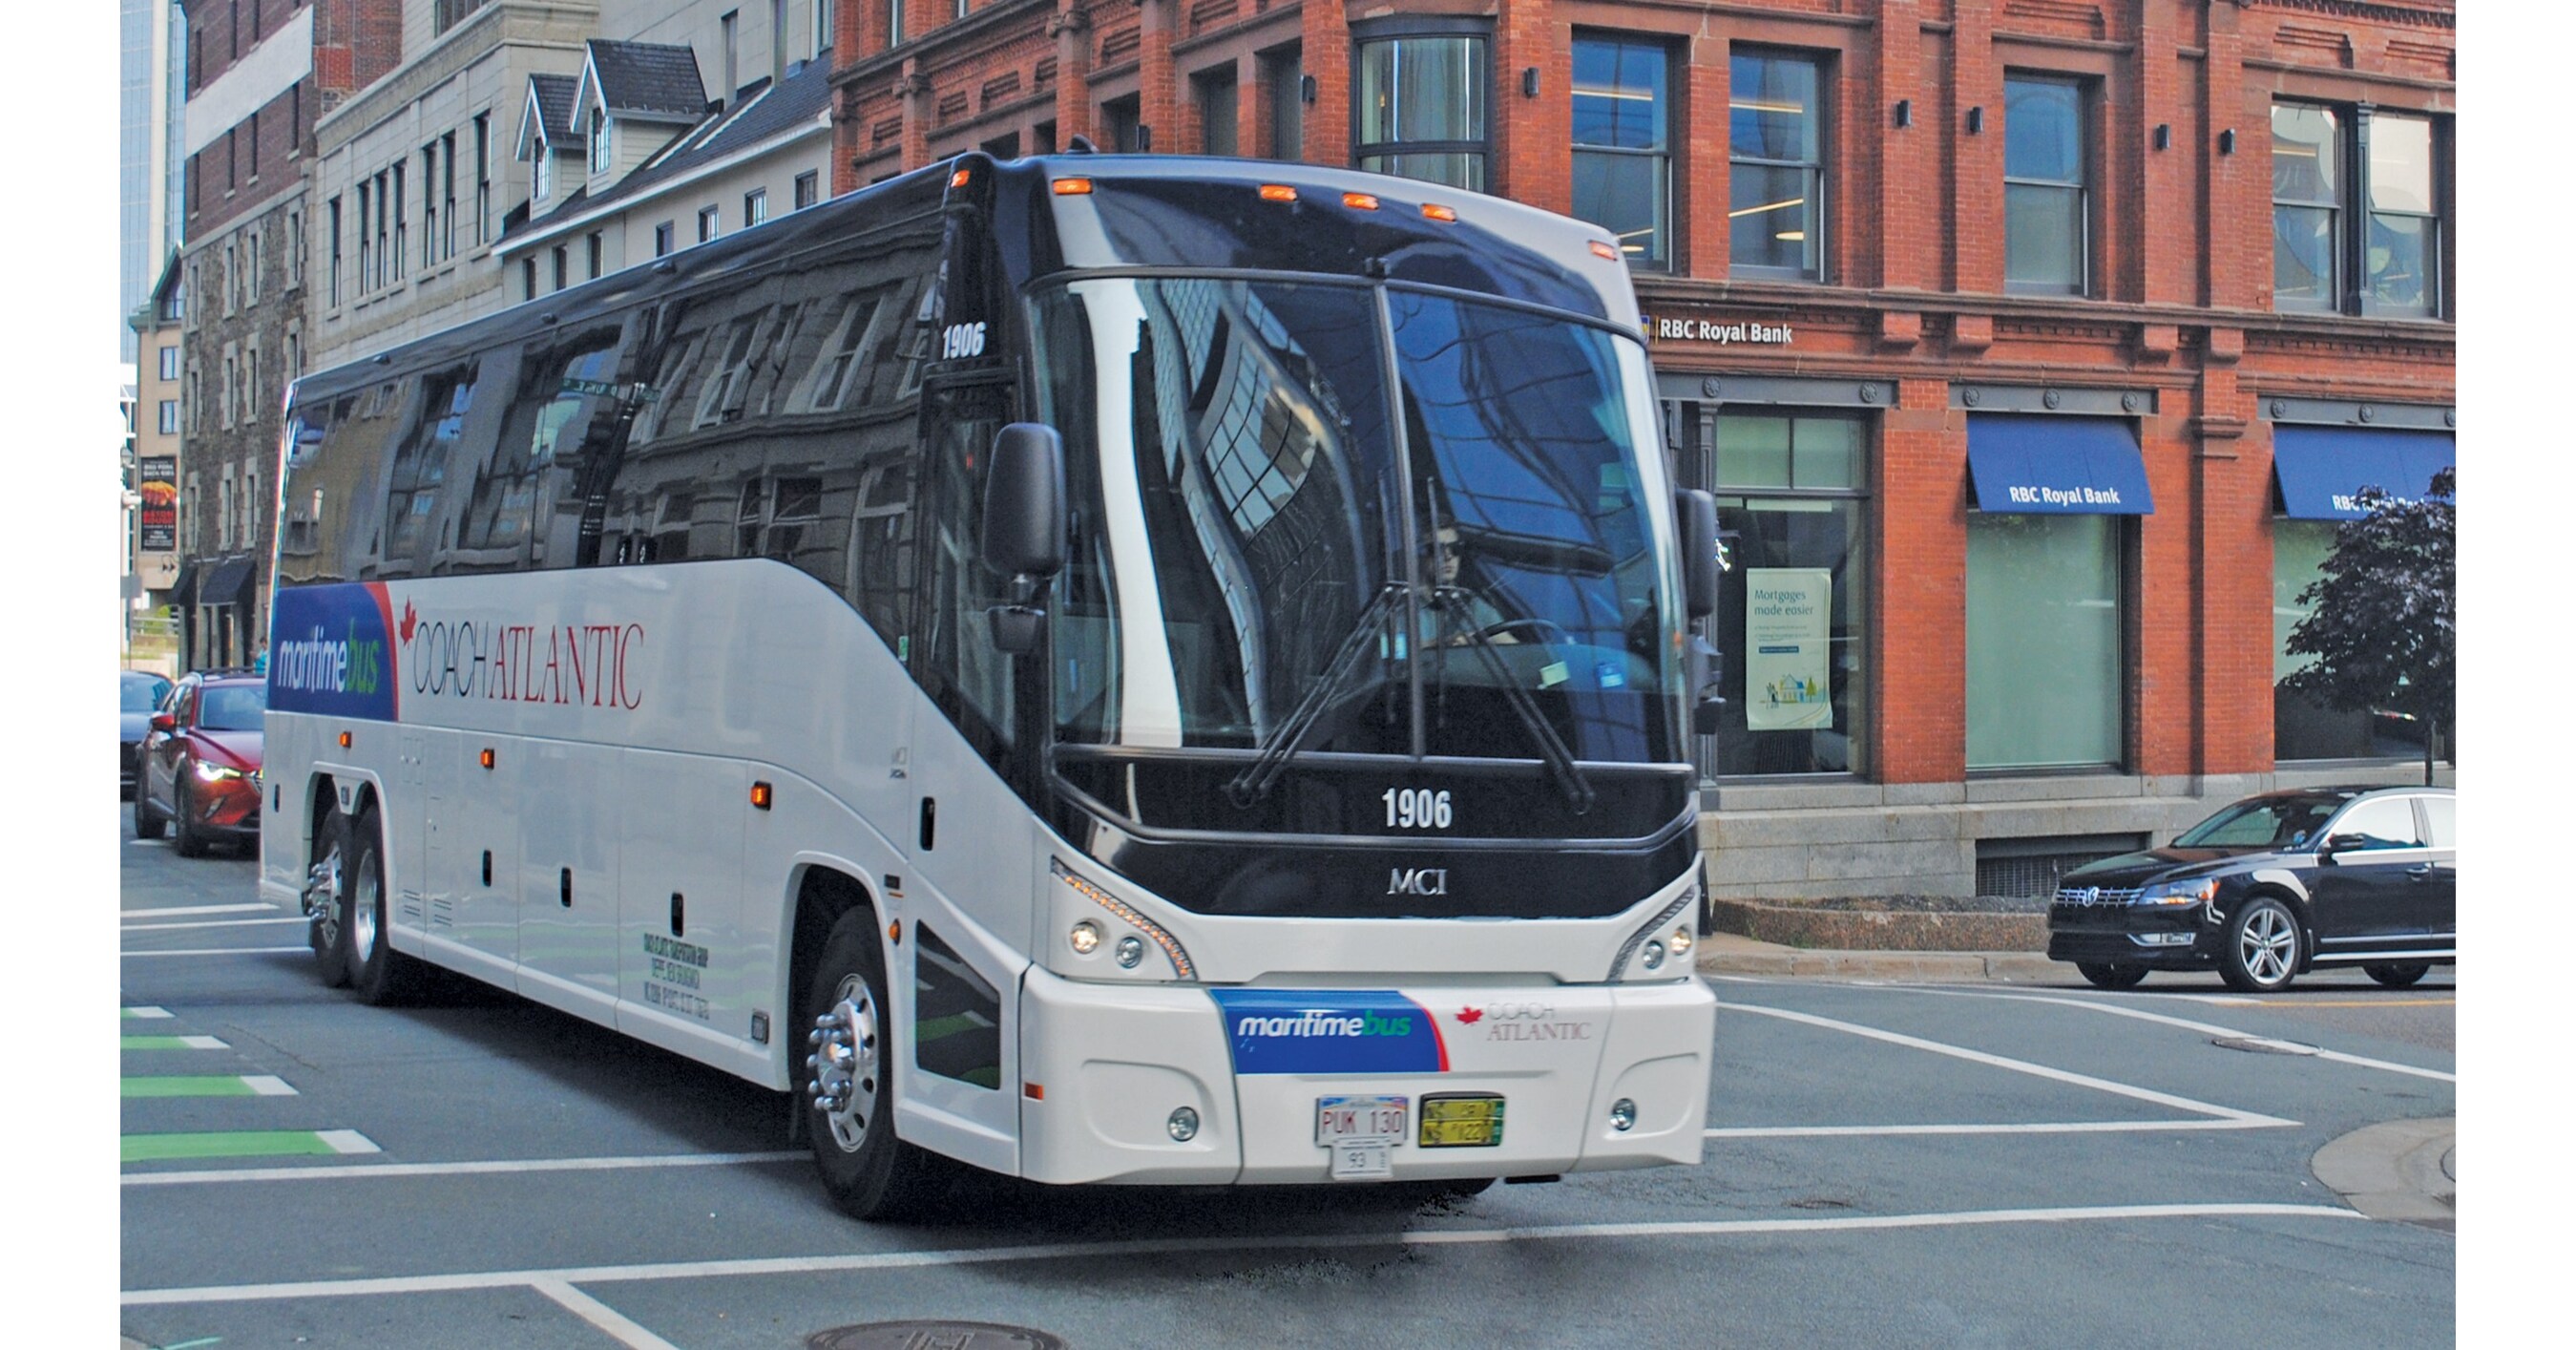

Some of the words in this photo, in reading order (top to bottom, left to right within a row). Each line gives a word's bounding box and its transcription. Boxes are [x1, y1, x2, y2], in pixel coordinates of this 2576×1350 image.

[942, 321, 987, 360] 1906
[1660, 319, 1694, 339] RBC
[1699, 321, 1747, 346] Royal
[1750, 323, 1792, 344] Bank
[2009, 487, 2040, 503] RBC
[2042, 487, 2083, 507] Royal
[2084, 487, 2121, 504] Bank
[1754, 589, 1806, 603] Mortgages
[1754, 603, 1783, 616] made
[1785, 603, 1813, 616] easier
[488, 622, 644, 710] ATLANTIC
[1381, 787, 1453, 829] 1906
[1386, 867, 1449, 896] MCI
[1238, 1009, 1413, 1038] maritimebus
[1487, 1002, 1555, 1021] COACH
[1486, 1022, 1591, 1042] ATLANTIC
[1321, 1109, 1357, 1134] PUK
[1370, 1109, 1402, 1133] 130
